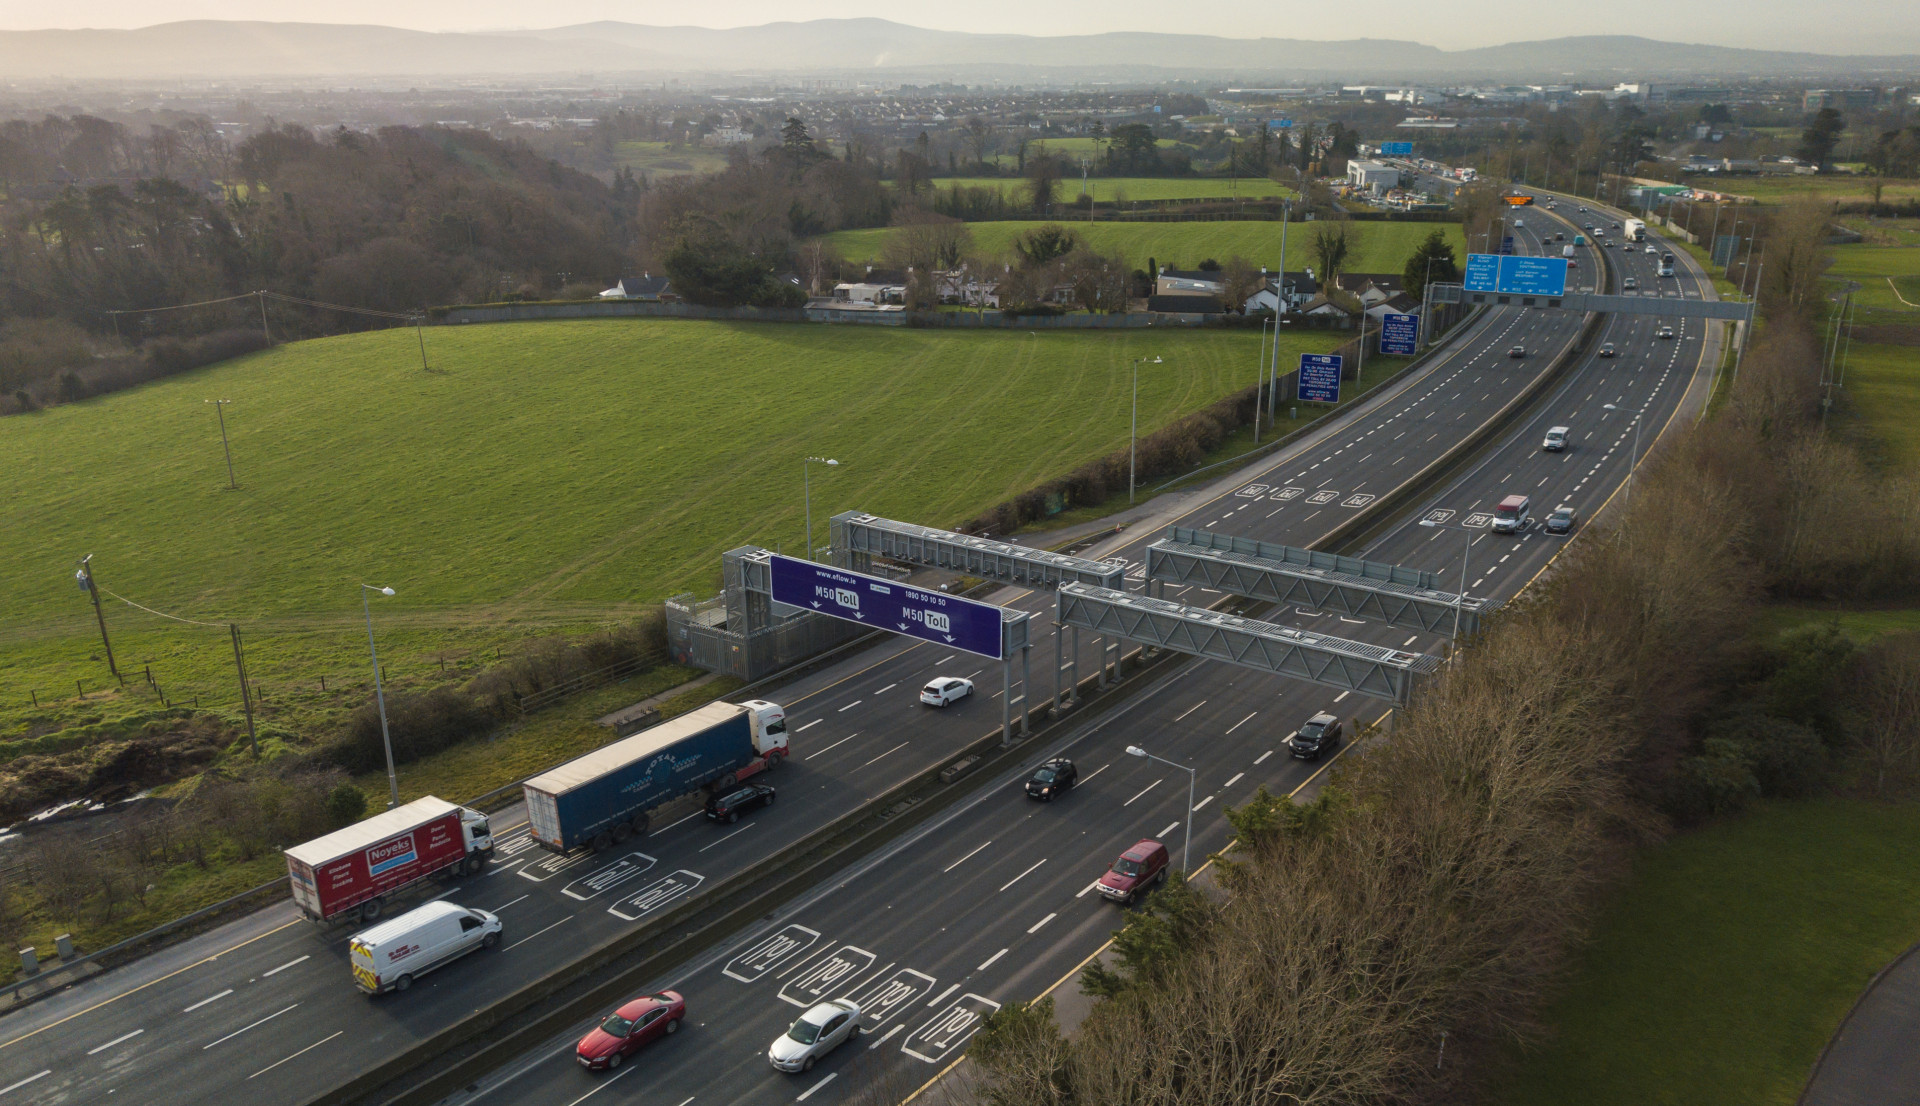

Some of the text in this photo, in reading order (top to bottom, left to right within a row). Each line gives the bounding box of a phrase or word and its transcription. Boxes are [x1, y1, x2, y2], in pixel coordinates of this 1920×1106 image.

[816, 570, 856, 585] www.eflow.ie
[815, 585, 857, 607] M50 Toll
[920, 593, 929, 602] 50
[929, 596, 937, 605] 10
[938, 597, 946, 606] 50
[903, 607, 947, 629] M50 Toll
[645, 754, 676, 775] TOTAL
[371, 840, 410, 861] Noyeks
[629, 878, 687, 909] Toll
[741, 934, 800, 971] Toll
[796, 957, 856, 995] Toll
[860, 980, 917, 1020] Toll
[919, 1007, 980, 1048] Toll
